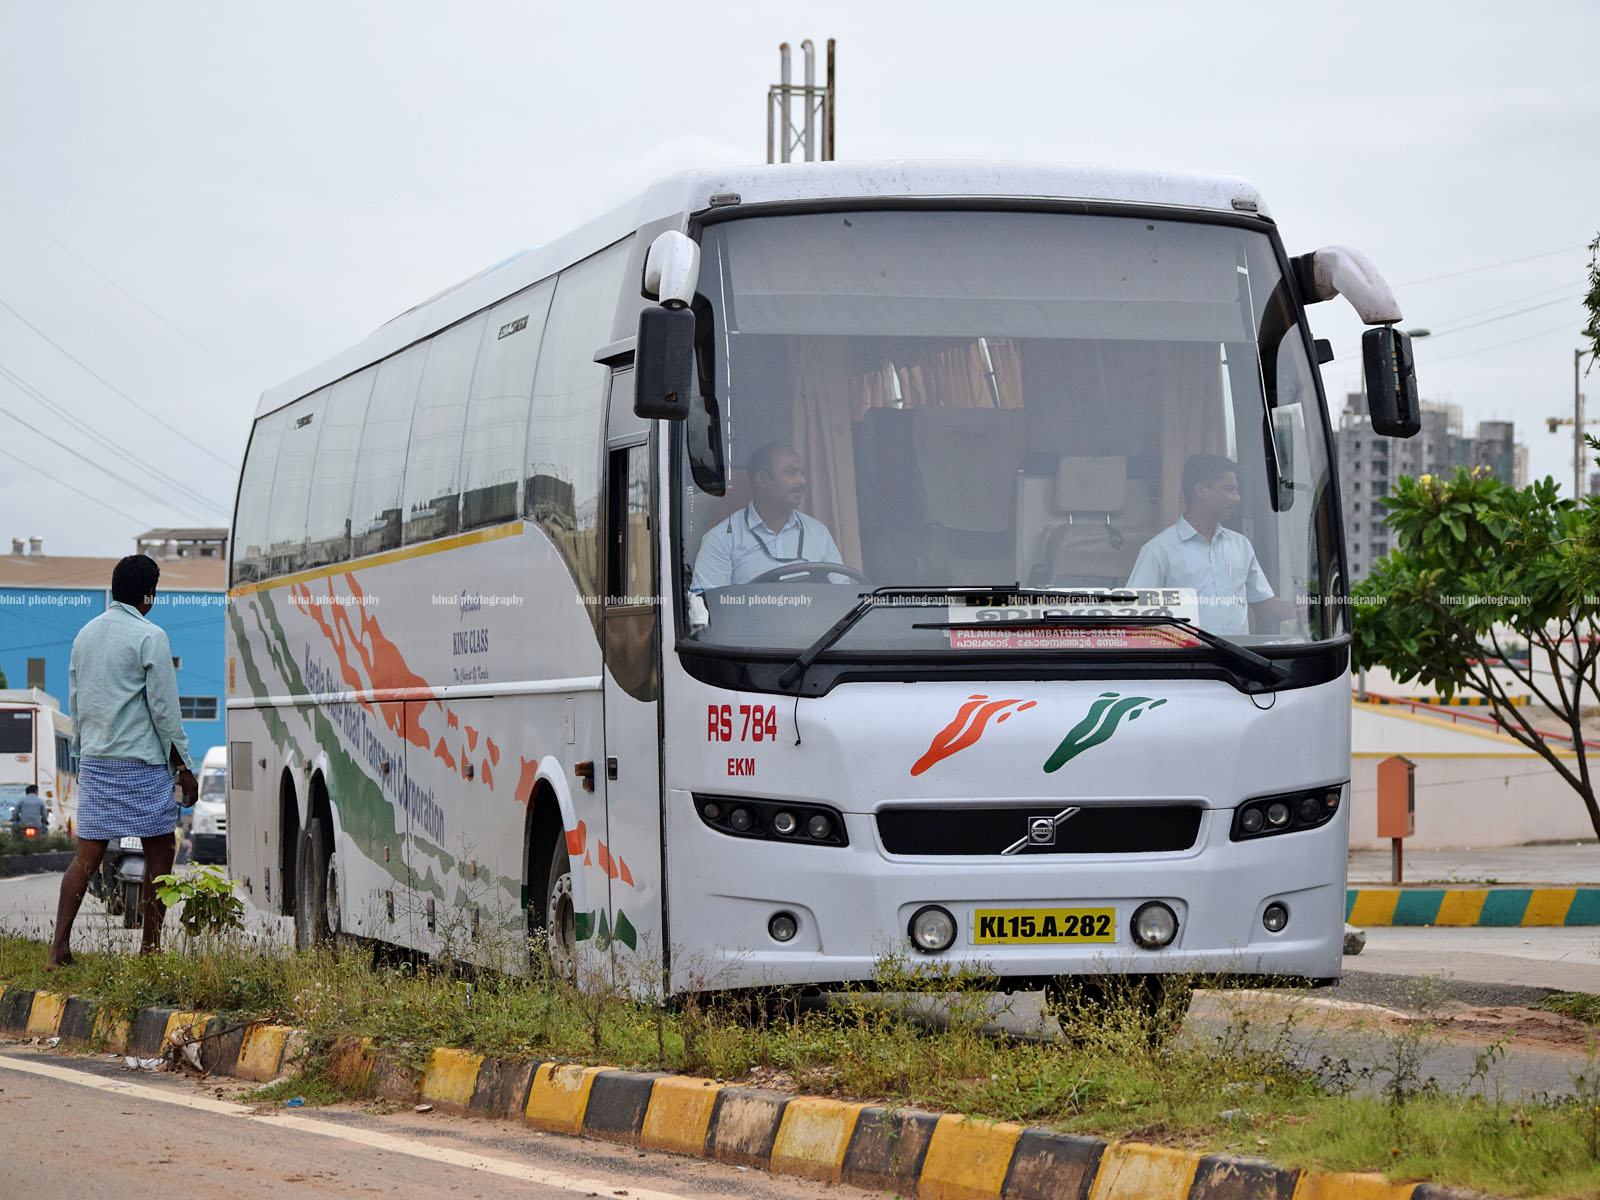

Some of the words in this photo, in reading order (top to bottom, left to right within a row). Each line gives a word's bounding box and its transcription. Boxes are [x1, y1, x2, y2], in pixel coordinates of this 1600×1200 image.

[469, 629, 488, 653] CLASS
[707, 704, 732, 742] RS
[739, 704, 777, 742] 784
[343, 691, 361, 750] Road
[361, 711, 397, 798] Transport
[397, 755, 445, 848] Corporation
[727, 758, 755, 776] EKM
[980, 914, 1111, 938] KL15.A.282
